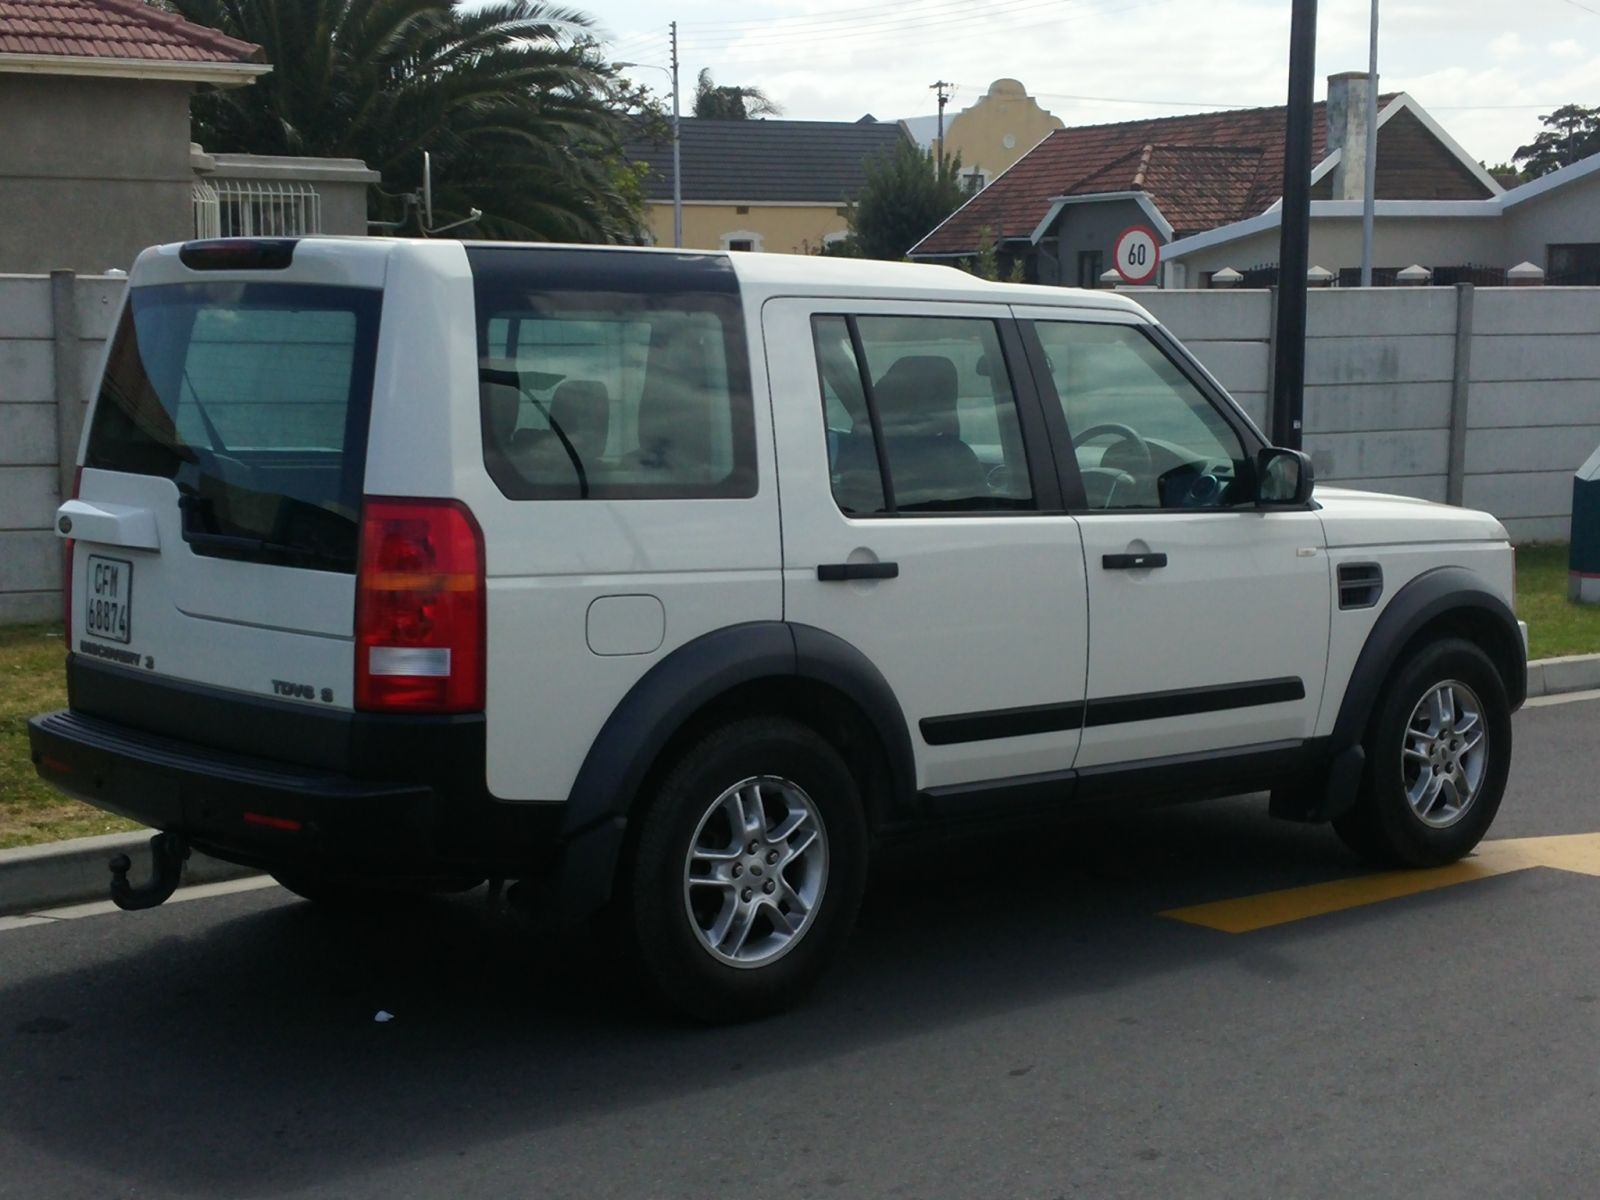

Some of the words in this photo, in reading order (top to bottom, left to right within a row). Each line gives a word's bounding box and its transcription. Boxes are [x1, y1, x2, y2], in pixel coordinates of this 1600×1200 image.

[1128, 243, 1146, 265] 60
[95, 563, 119, 598] CFM
[88, 598, 126, 636] 68874
